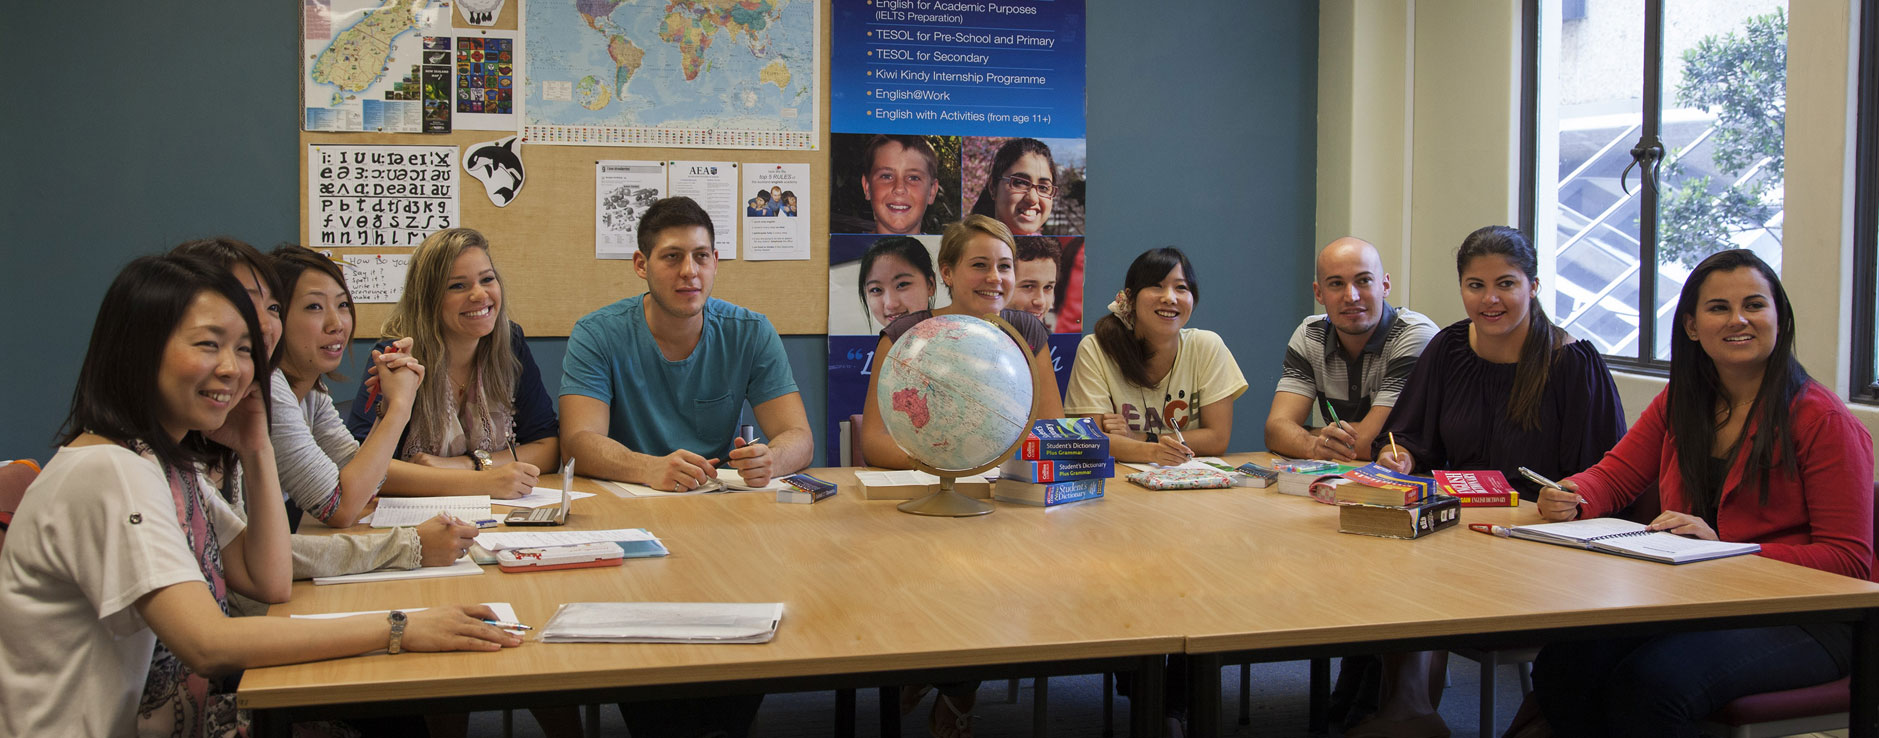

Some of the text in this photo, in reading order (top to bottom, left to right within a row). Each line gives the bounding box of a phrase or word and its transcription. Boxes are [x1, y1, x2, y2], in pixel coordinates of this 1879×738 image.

[876, 0, 1037, 15] English for Academic Purposes
[875, 11, 963, 24] (IELTS Preparation)
[876, 29, 1055, 48] TESOL for Pre-School and Primary
[876, 49, 989, 64] TESOL for Secondary
[875, 69, 1046, 85] Kiwi Kindy Internship Programme
[875, 88, 950, 101] English@Work
[875, 108, 1051, 124] English with Activities (from age 11+)
[689, 166, 710, 175] AEA
[1121, 389, 1201, 432] EACE
[1060, 482, 1088, 493] Student's
[1059, 491, 1086, 500] Dictionary
